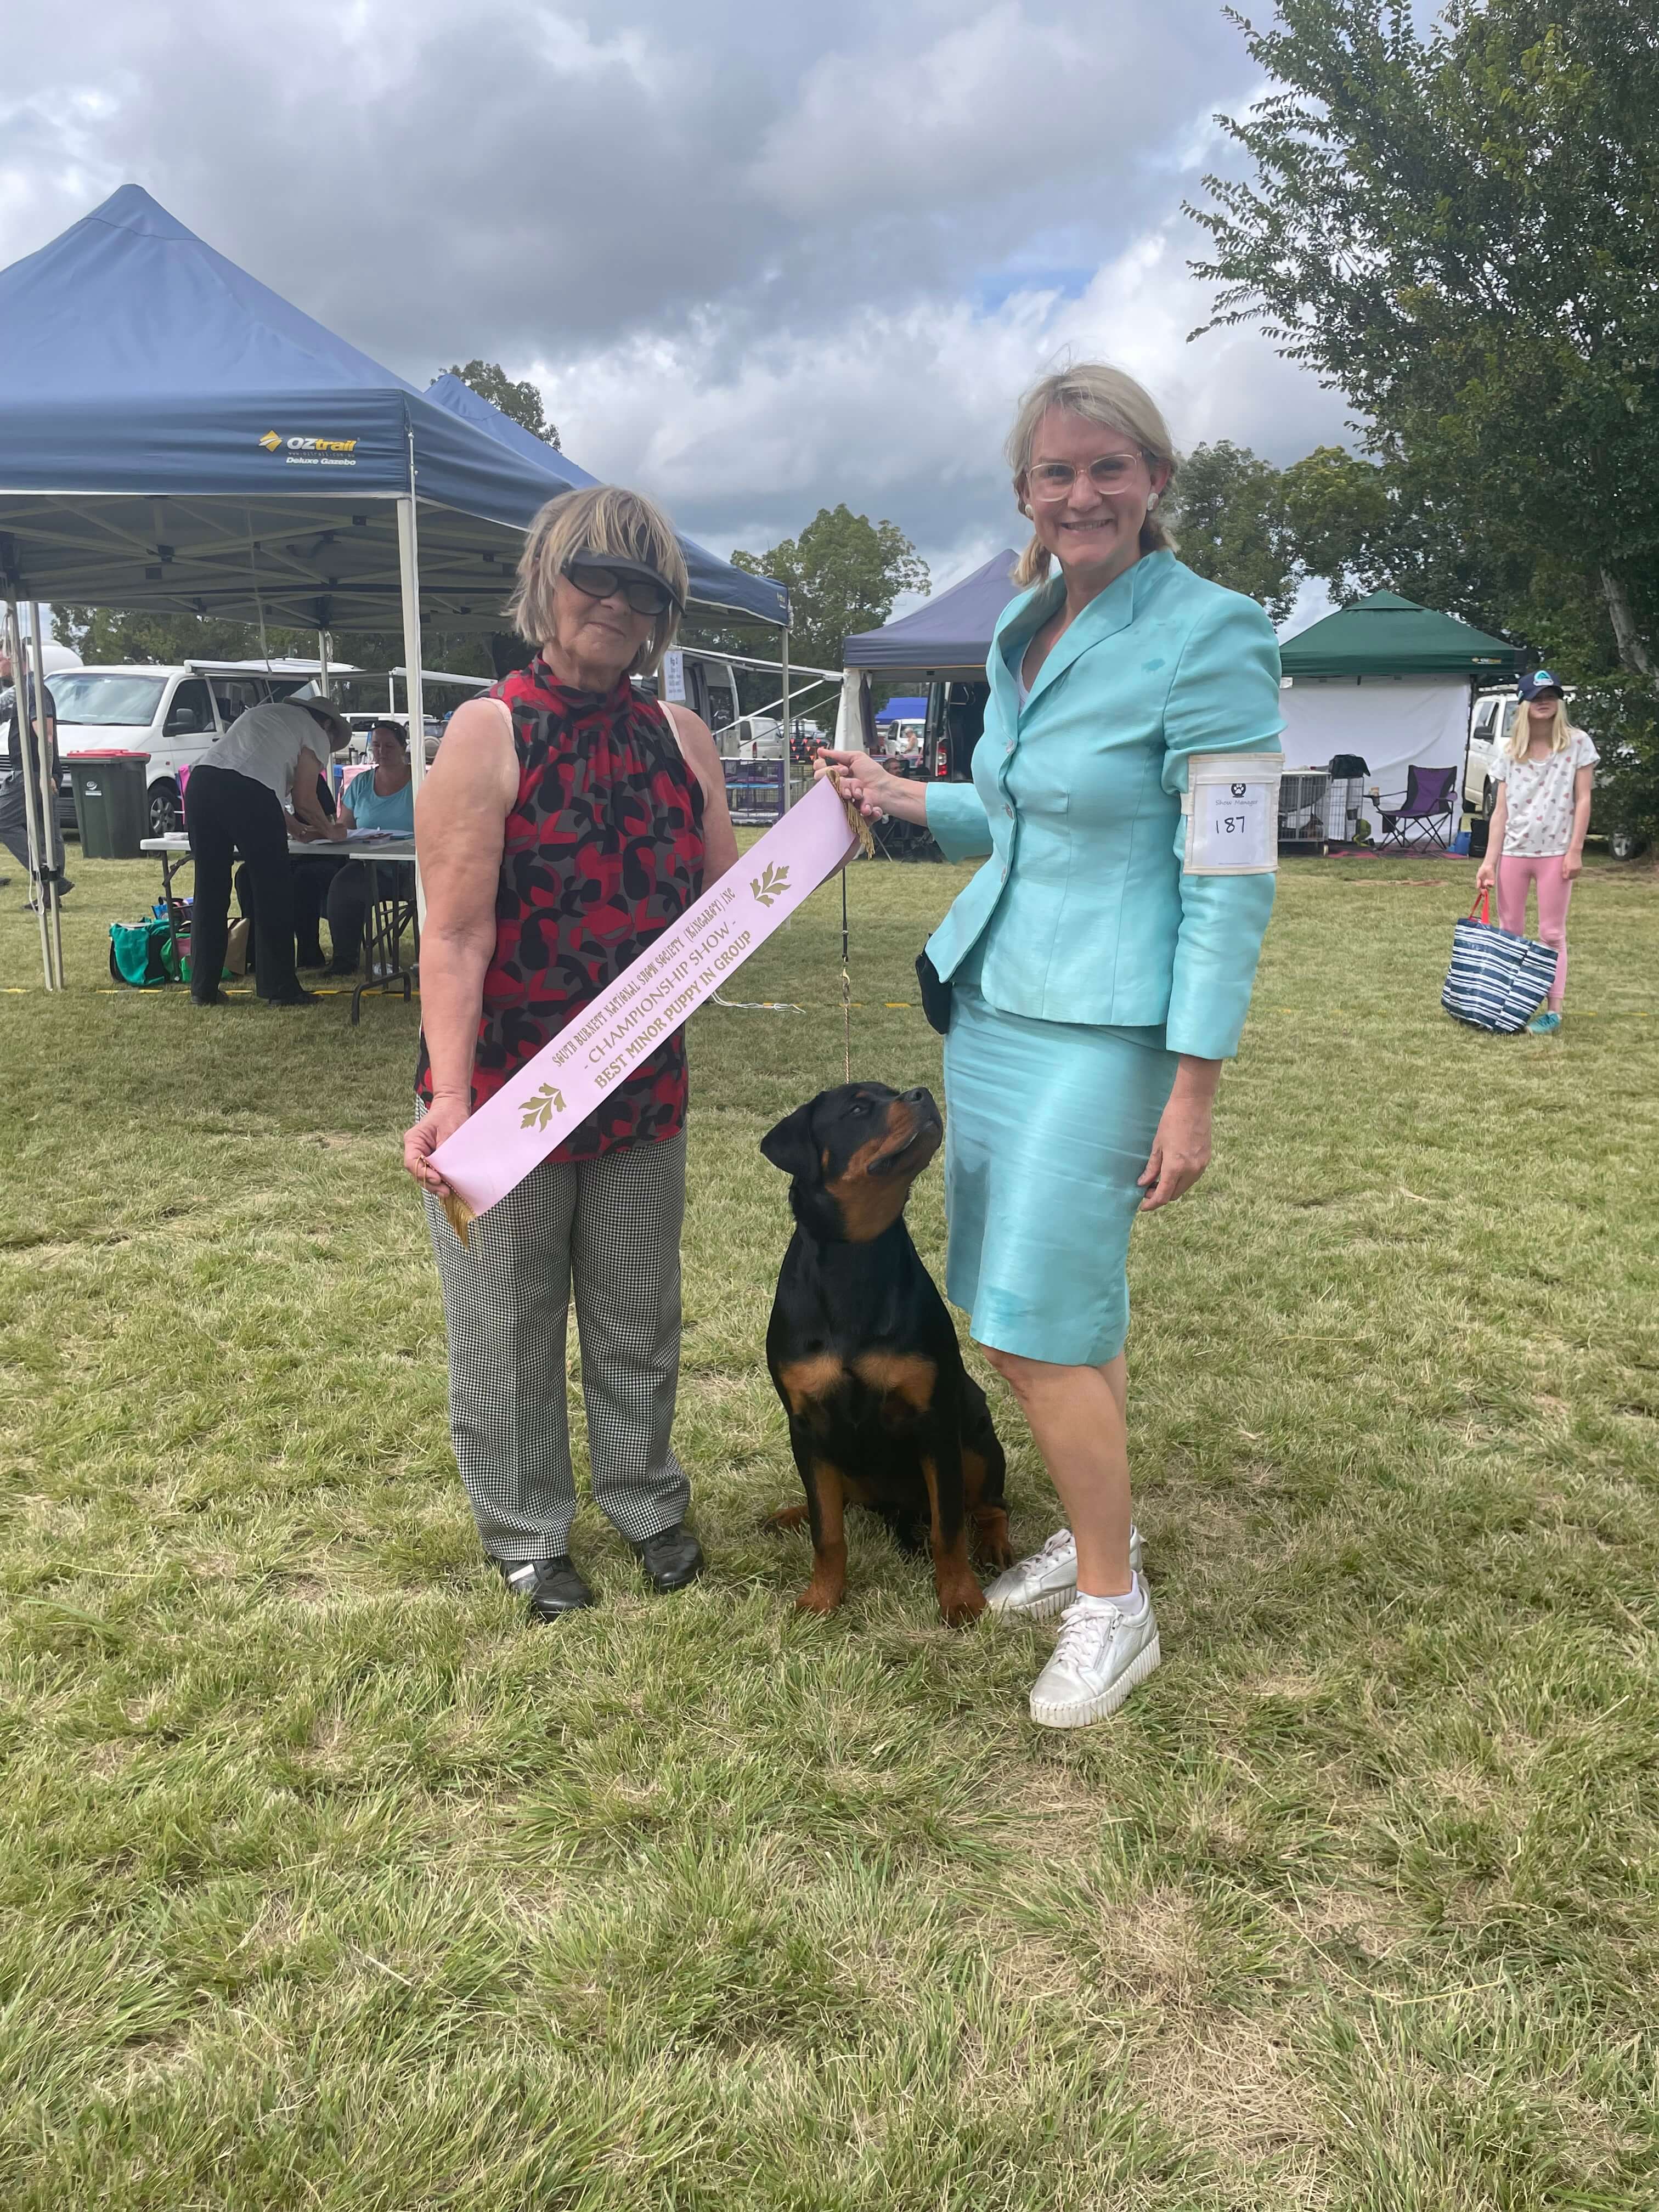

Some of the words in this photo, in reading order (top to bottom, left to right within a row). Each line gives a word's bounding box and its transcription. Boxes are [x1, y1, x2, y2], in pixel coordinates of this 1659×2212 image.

[287, 437, 357, 452] OZtrail
[1216, 816, 1245, 833] 187
[552, 1040, 577, 1066] SOUTH
[573, 1011, 607, 1046] BURNETT
[636, 962, 658, 985] SHOW
[589, 961, 688, 1063] CHAMPIONSHIP
[689, 921, 729, 966] SHOW
[594, 1053, 627, 1088] BEST
[625, 1017, 667, 1058] MINOR
[663, 980, 701, 1022] PUPPY
[698, 967, 716, 985] IN
[714, 930, 750, 970] GROUP
